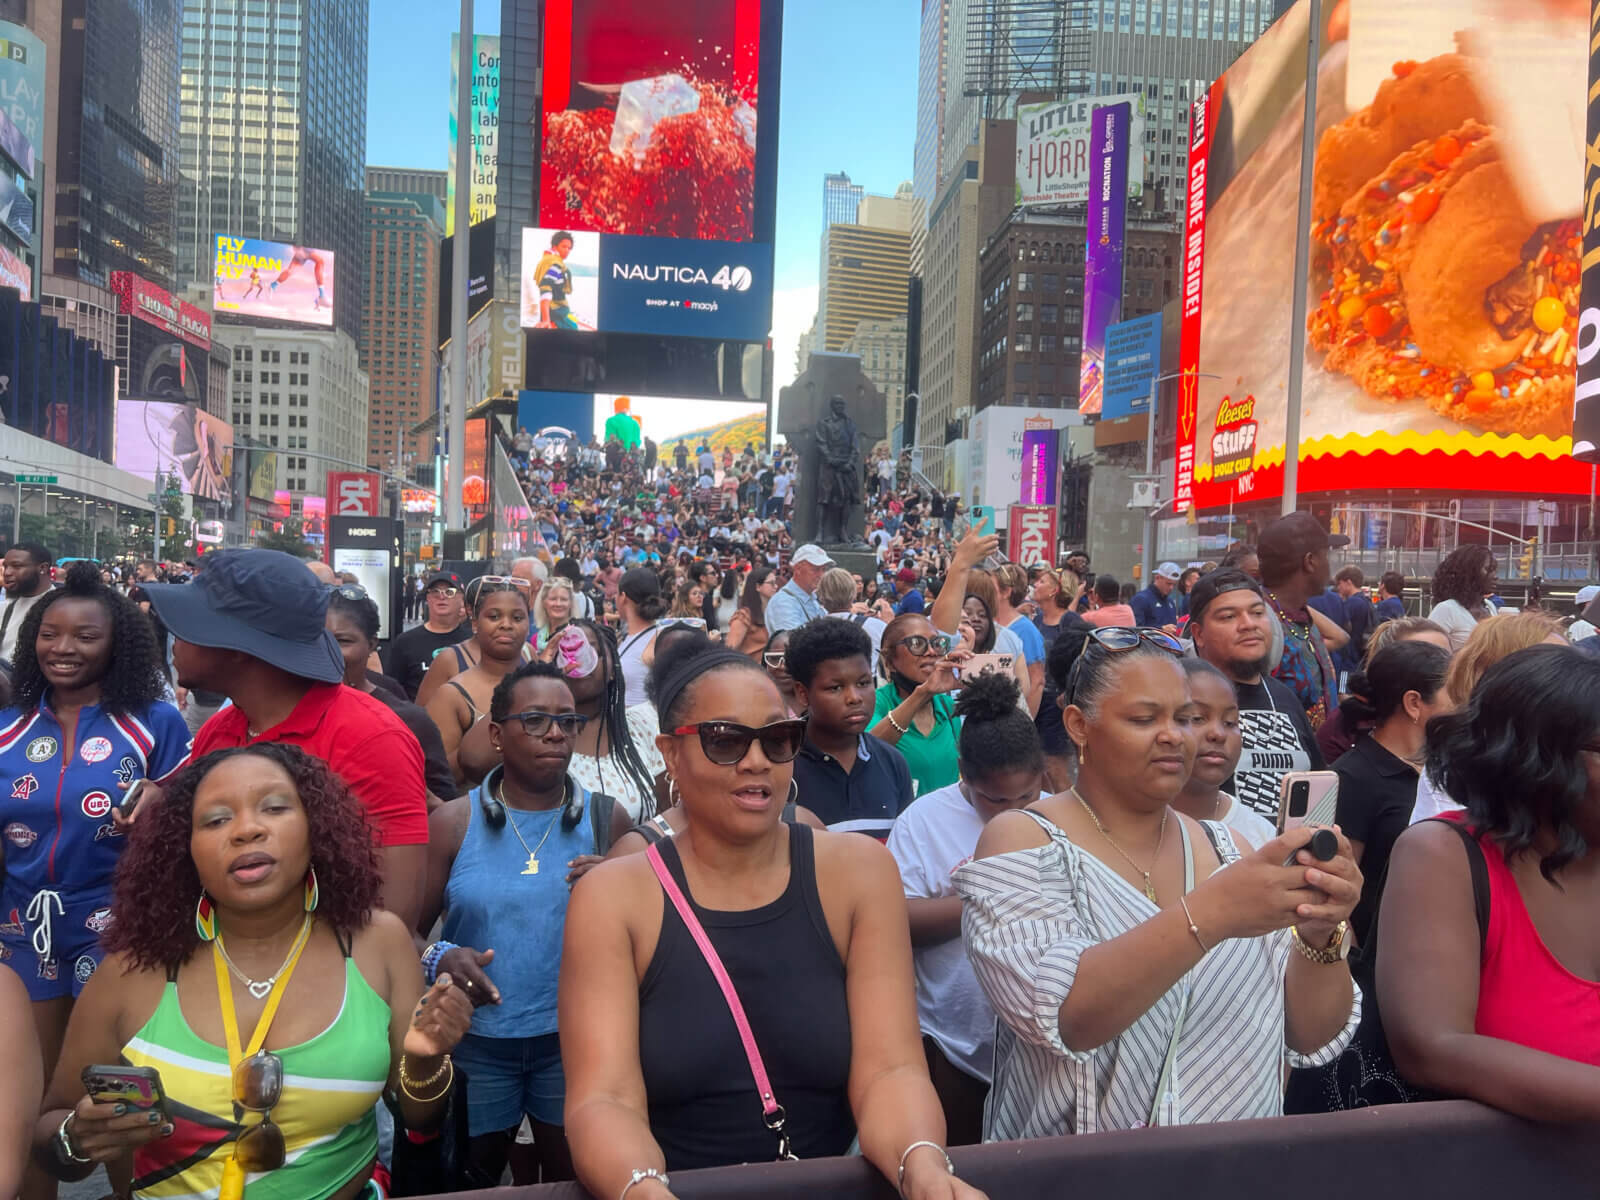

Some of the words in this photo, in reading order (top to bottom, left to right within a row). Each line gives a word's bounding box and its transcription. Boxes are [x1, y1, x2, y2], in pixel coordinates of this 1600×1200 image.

[1030, 103, 1087, 139] LITTLE
[1189, 158, 1205, 229] COME
[217, 236, 245, 252] FLY
[216, 265, 244, 279] FLY
[217, 250, 282, 272] HUMAN
[1186, 229, 1203, 318] INSIDE!
[613, 263, 708, 284] NAUTICA
[711, 265, 752, 291] 40
[1216, 399, 1253, 427] Reese's
[1239, 472, 1255, 496] NYC
[1020, 511, 1051, 569] tkts
[1251, 753, 1294, 769] PUMA
